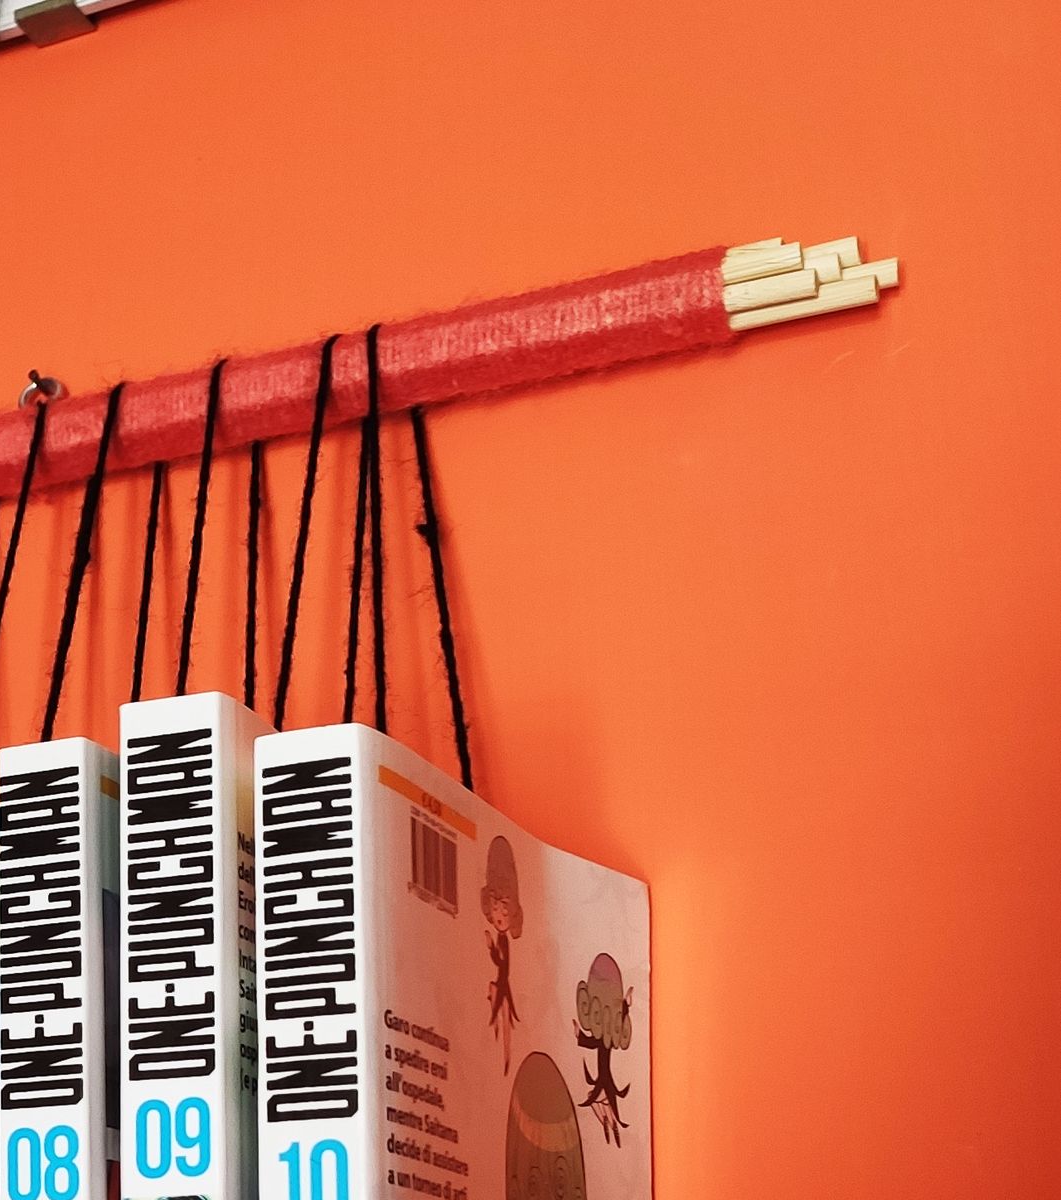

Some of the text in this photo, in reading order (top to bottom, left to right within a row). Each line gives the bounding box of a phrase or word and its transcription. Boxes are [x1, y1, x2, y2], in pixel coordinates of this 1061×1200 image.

[0, 767, 80, 861] MAN
[128, 729, 212, 825] MAN
[262, 757, 353, 858] MAN
[385, 1044, 392, 1059] a
[136, 1097, 211, 1179] 09
[388, 1170, 395, 1185] a
